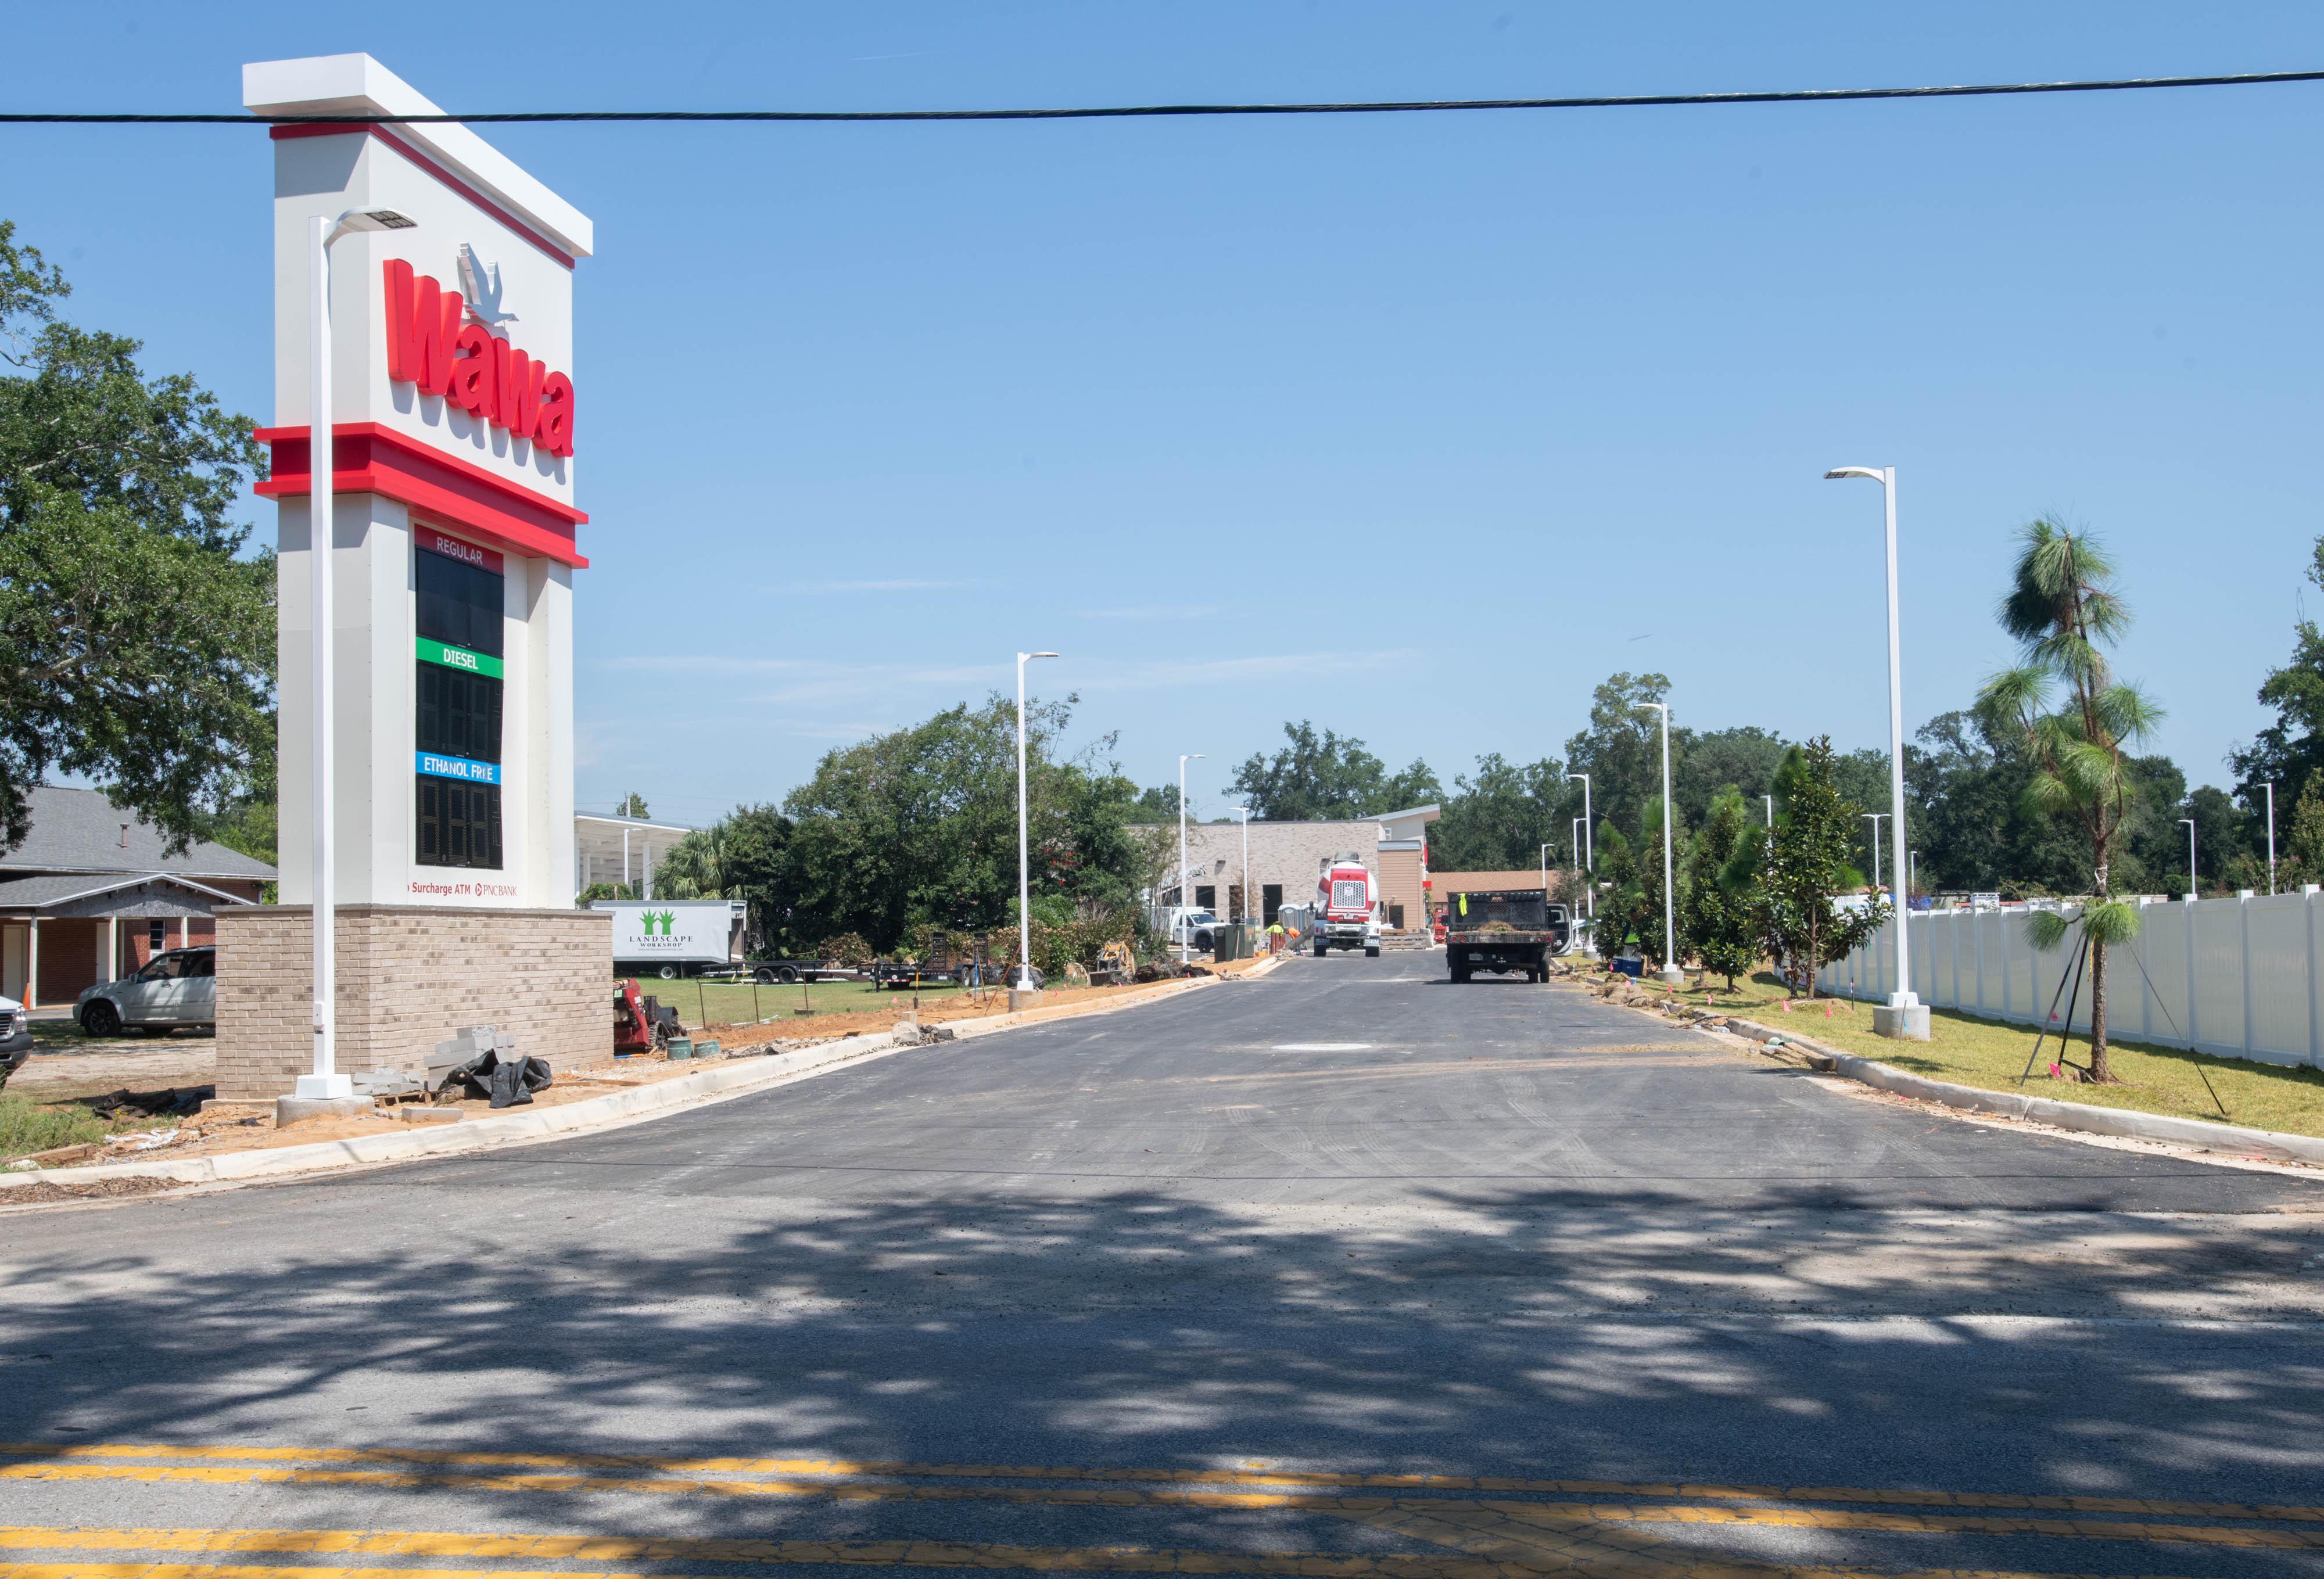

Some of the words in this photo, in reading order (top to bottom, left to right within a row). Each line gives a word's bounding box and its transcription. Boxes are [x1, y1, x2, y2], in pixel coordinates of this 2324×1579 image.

[383, 259, 574, 457] Wawa
[437, 536, 483, 565] REGULAR
[444, 648, 478, 669] DIESEL
[425, 757, 469, 777] ETHANOL
[412, 882, 452, 896] Surcharge
[454, 884, 470, 895] ATM
